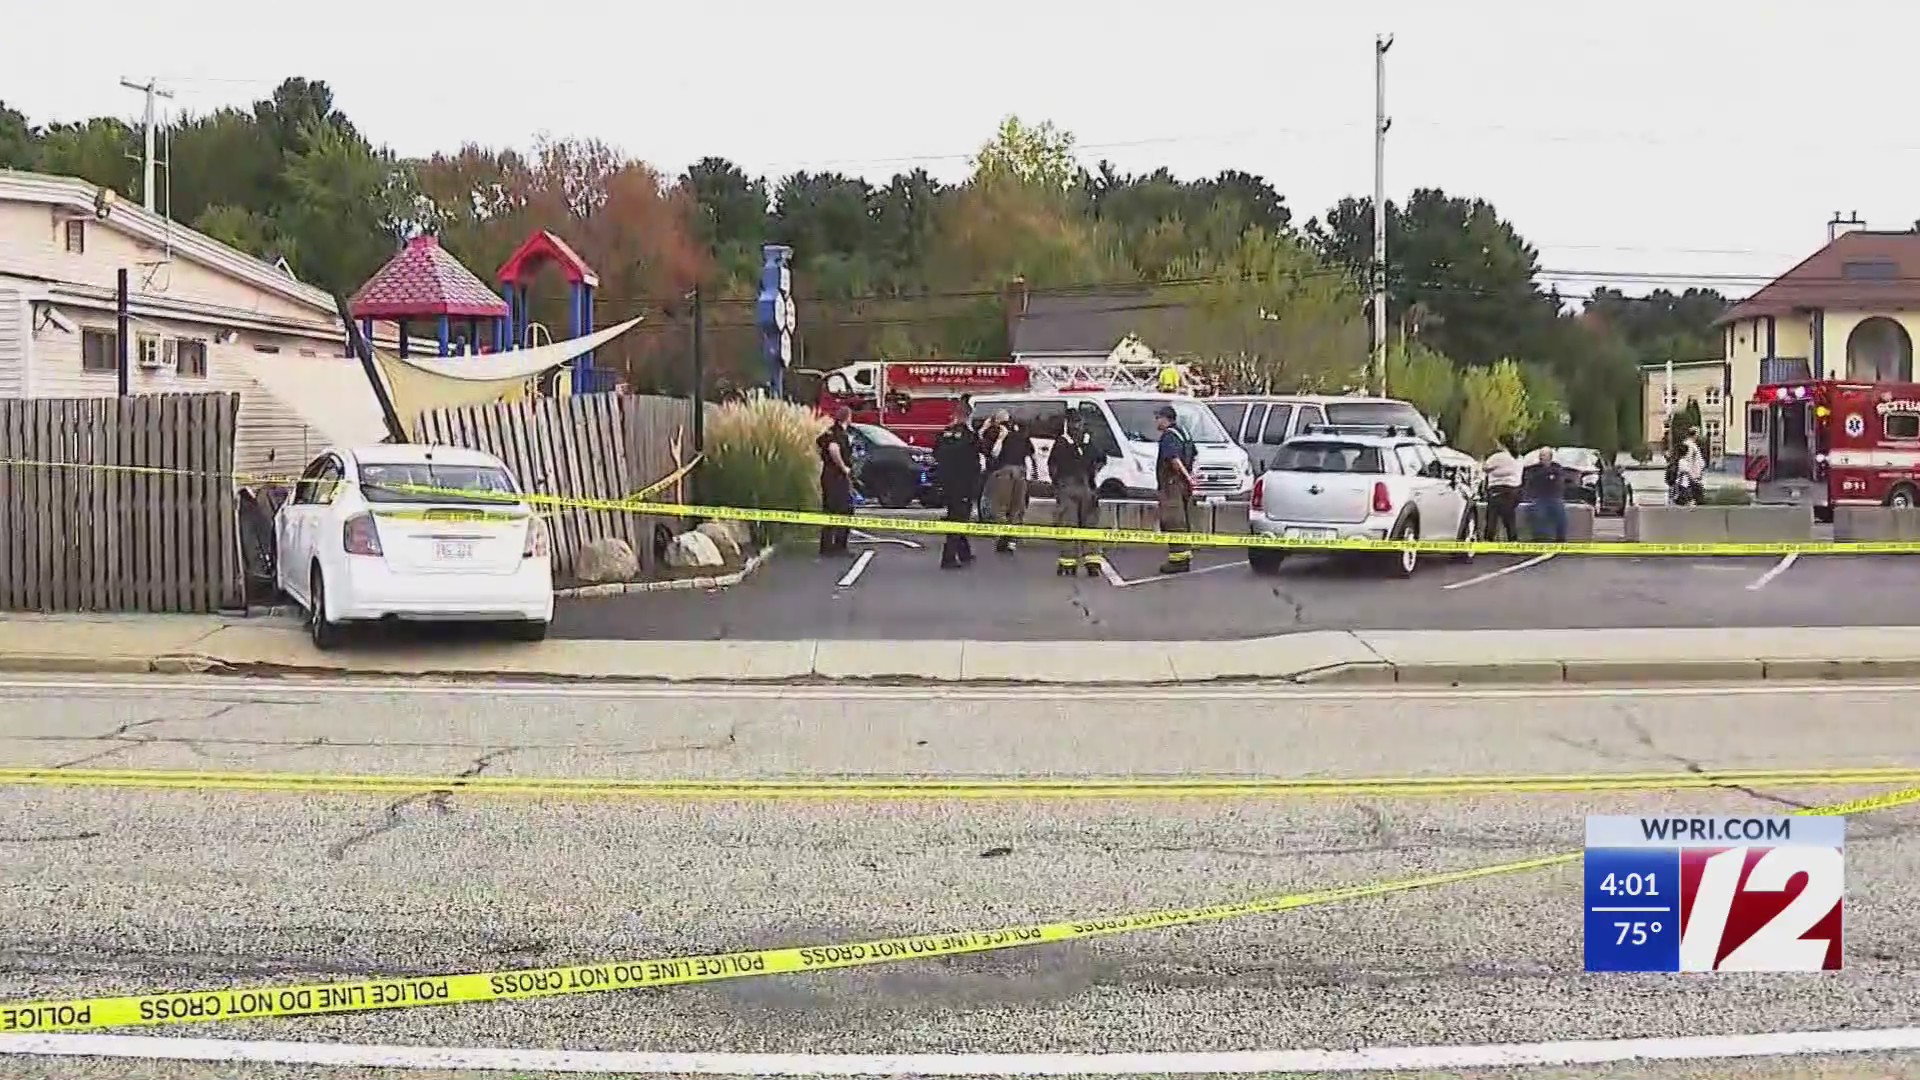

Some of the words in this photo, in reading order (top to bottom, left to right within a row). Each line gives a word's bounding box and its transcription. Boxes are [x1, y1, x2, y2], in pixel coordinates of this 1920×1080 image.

[908, 366, 973, 376] HOPKINS
[976, 366, 1010, 377] HILL
[800, 949, 866, 966] CROSS
[871, 944, 906, 958] NOT
[614, 964, 643, 984] DO
[649, 961, 689, 980] LINE
[697, 954, 765, 976] POLICE
[491, 971, 563, 995] CROSS
[569, 967, 610, 988] NOT
[279, 990, 311, 1009] DO
[318, 986, 366, 1008] LINE
[372, 981, 449, 1004] POLICE
[140, 995, 221, 1020] CROSS
[227, 993, 273, 1014] NOT
[3, 1005, 92, 1030] POLICE
